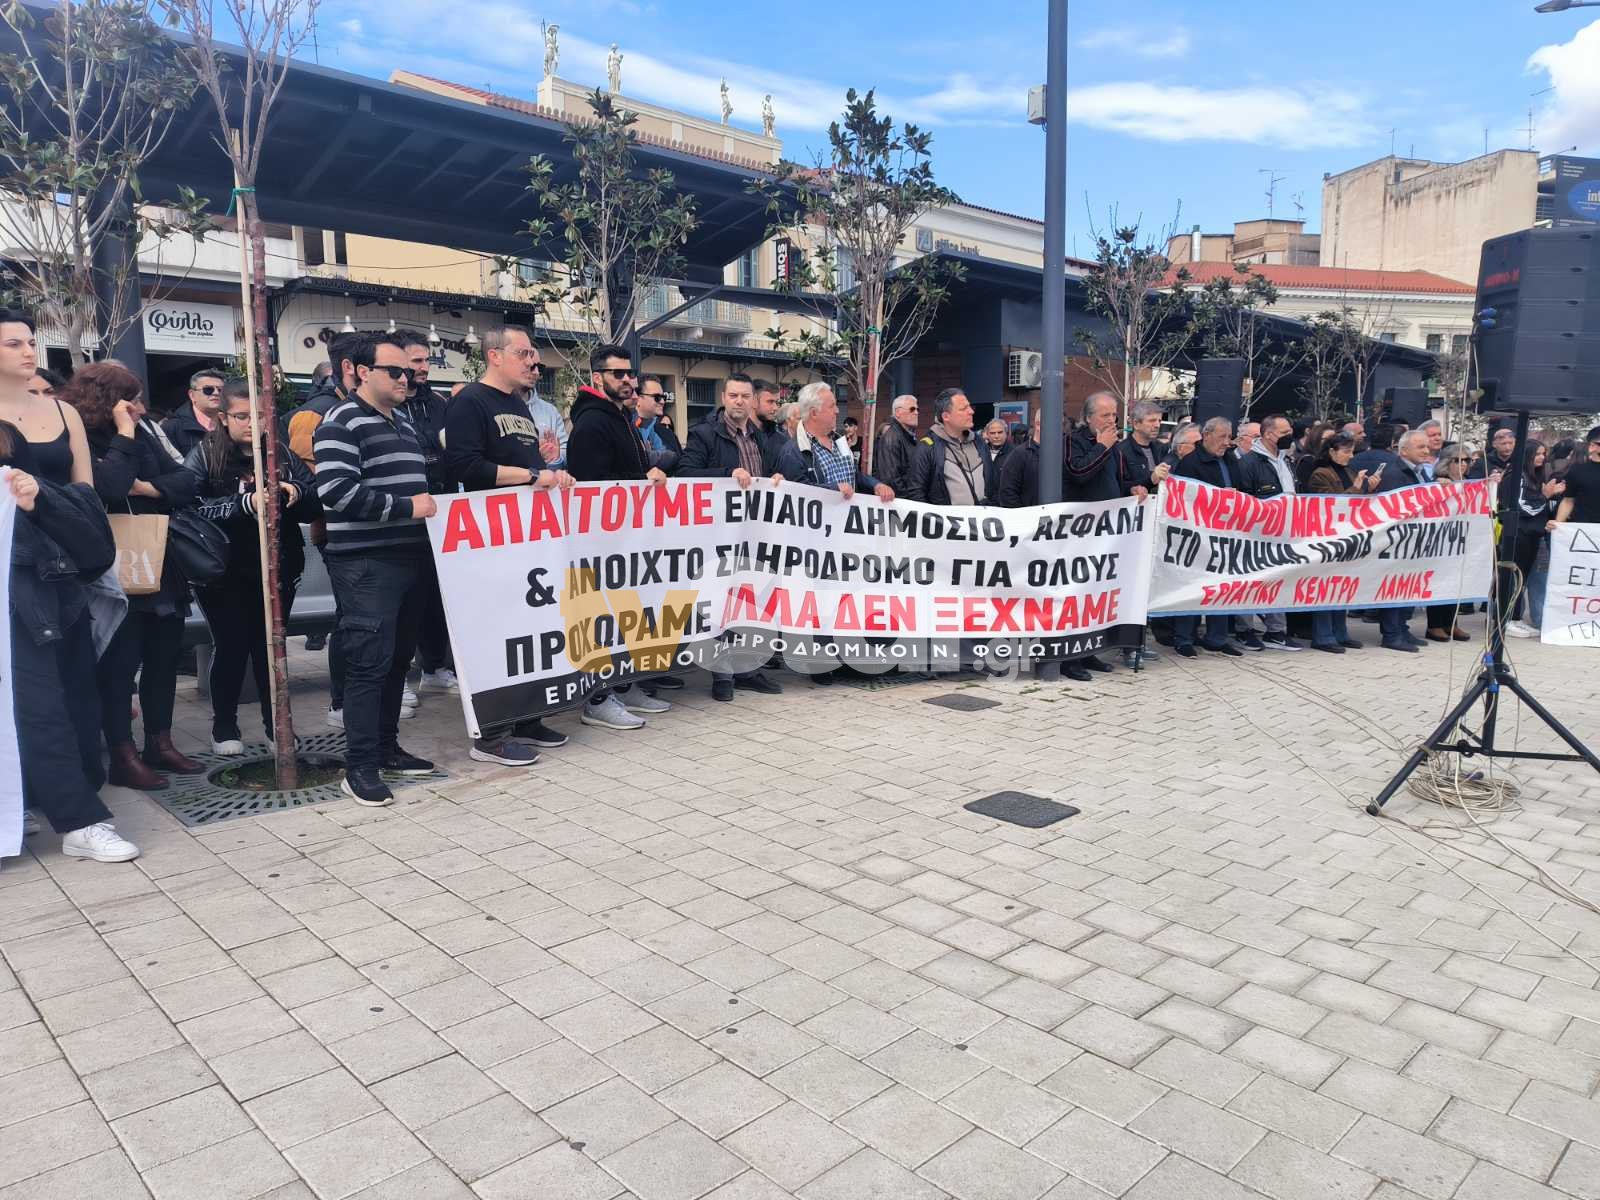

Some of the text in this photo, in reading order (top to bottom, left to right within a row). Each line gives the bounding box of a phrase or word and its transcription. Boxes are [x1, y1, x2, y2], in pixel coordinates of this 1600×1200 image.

[442, 483, 1145, 553] ΑΠΑΙΤΟΥΜΕ ΕΝΙΑΙΟ, ΔΗΜΟΣΙΟ, ΑΣΦΑΛΗ
[1166, 478, 1188, 520] ΟΙ
[1194, 485, 1287, 537] ΝΕΚΡΟΙ
[115, 550, 156, 585] RA
[526, 541, 1120, 608] & ΑΝΟΙΧΤΟ ΣΙΔΗΡΟΔΡΟΜΟ ΓΙΑ ΟΛΟΥΣ
[1164, 525, 1201, 568] ΣΤΟ
[1293, 575, 1361, 605] ΚΕΝΤΡΟ
[1375, 570, 1434, 600] ΛΑΜΙΑΣ
[505, 583, 1121, 678] ΠΡΟΧΩΡΑΜΕ ΑΛΛΑ ΔΕΝ ΞΕΧΝΑΜΕ
[546, 633, 1104, 706] ΕΡΓΑΖΟΜΕΝΟΙ ΣΙΔΗΡΟΔΡΟΜΙΚΟΙ Ν. ΦΘΙΩΤΙΔΑΣ
